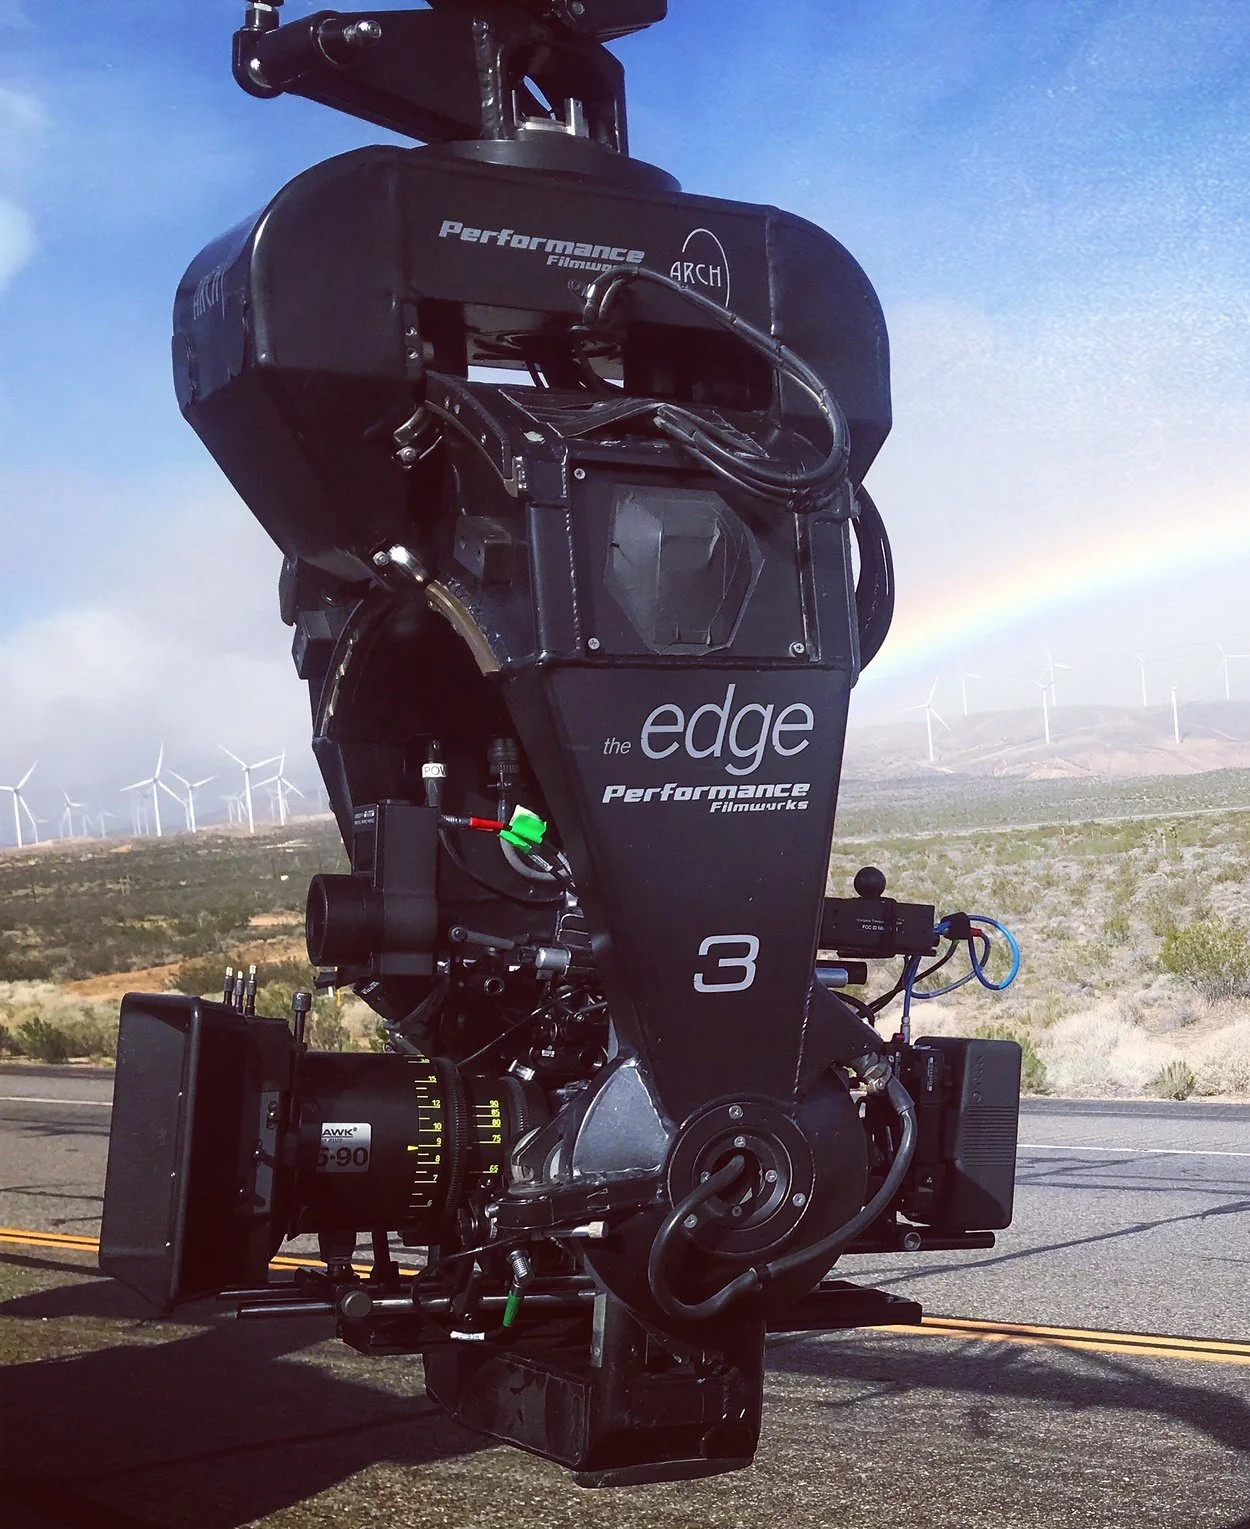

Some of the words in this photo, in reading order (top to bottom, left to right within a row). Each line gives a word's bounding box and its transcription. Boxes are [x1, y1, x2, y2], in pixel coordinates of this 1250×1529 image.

[438, 219, 646, 264] Performance
[546, 254, 630, 273] Filmwo
[670, 261, 722, 287] ARCH
[603, 737, 631, 754] the
[641, 683, 815, 776] edge
[602, 782, 811, 804] Performance
[710, 799, 809, 813] Filmworks
[693, 934, 760, 993] 3
[323, 1128, 353, 1136] AWK
[432, 1122, 442, 1130] 10
[492, 1134, 501, 1142] 75
[489, 1164, 499, 1172] 65
